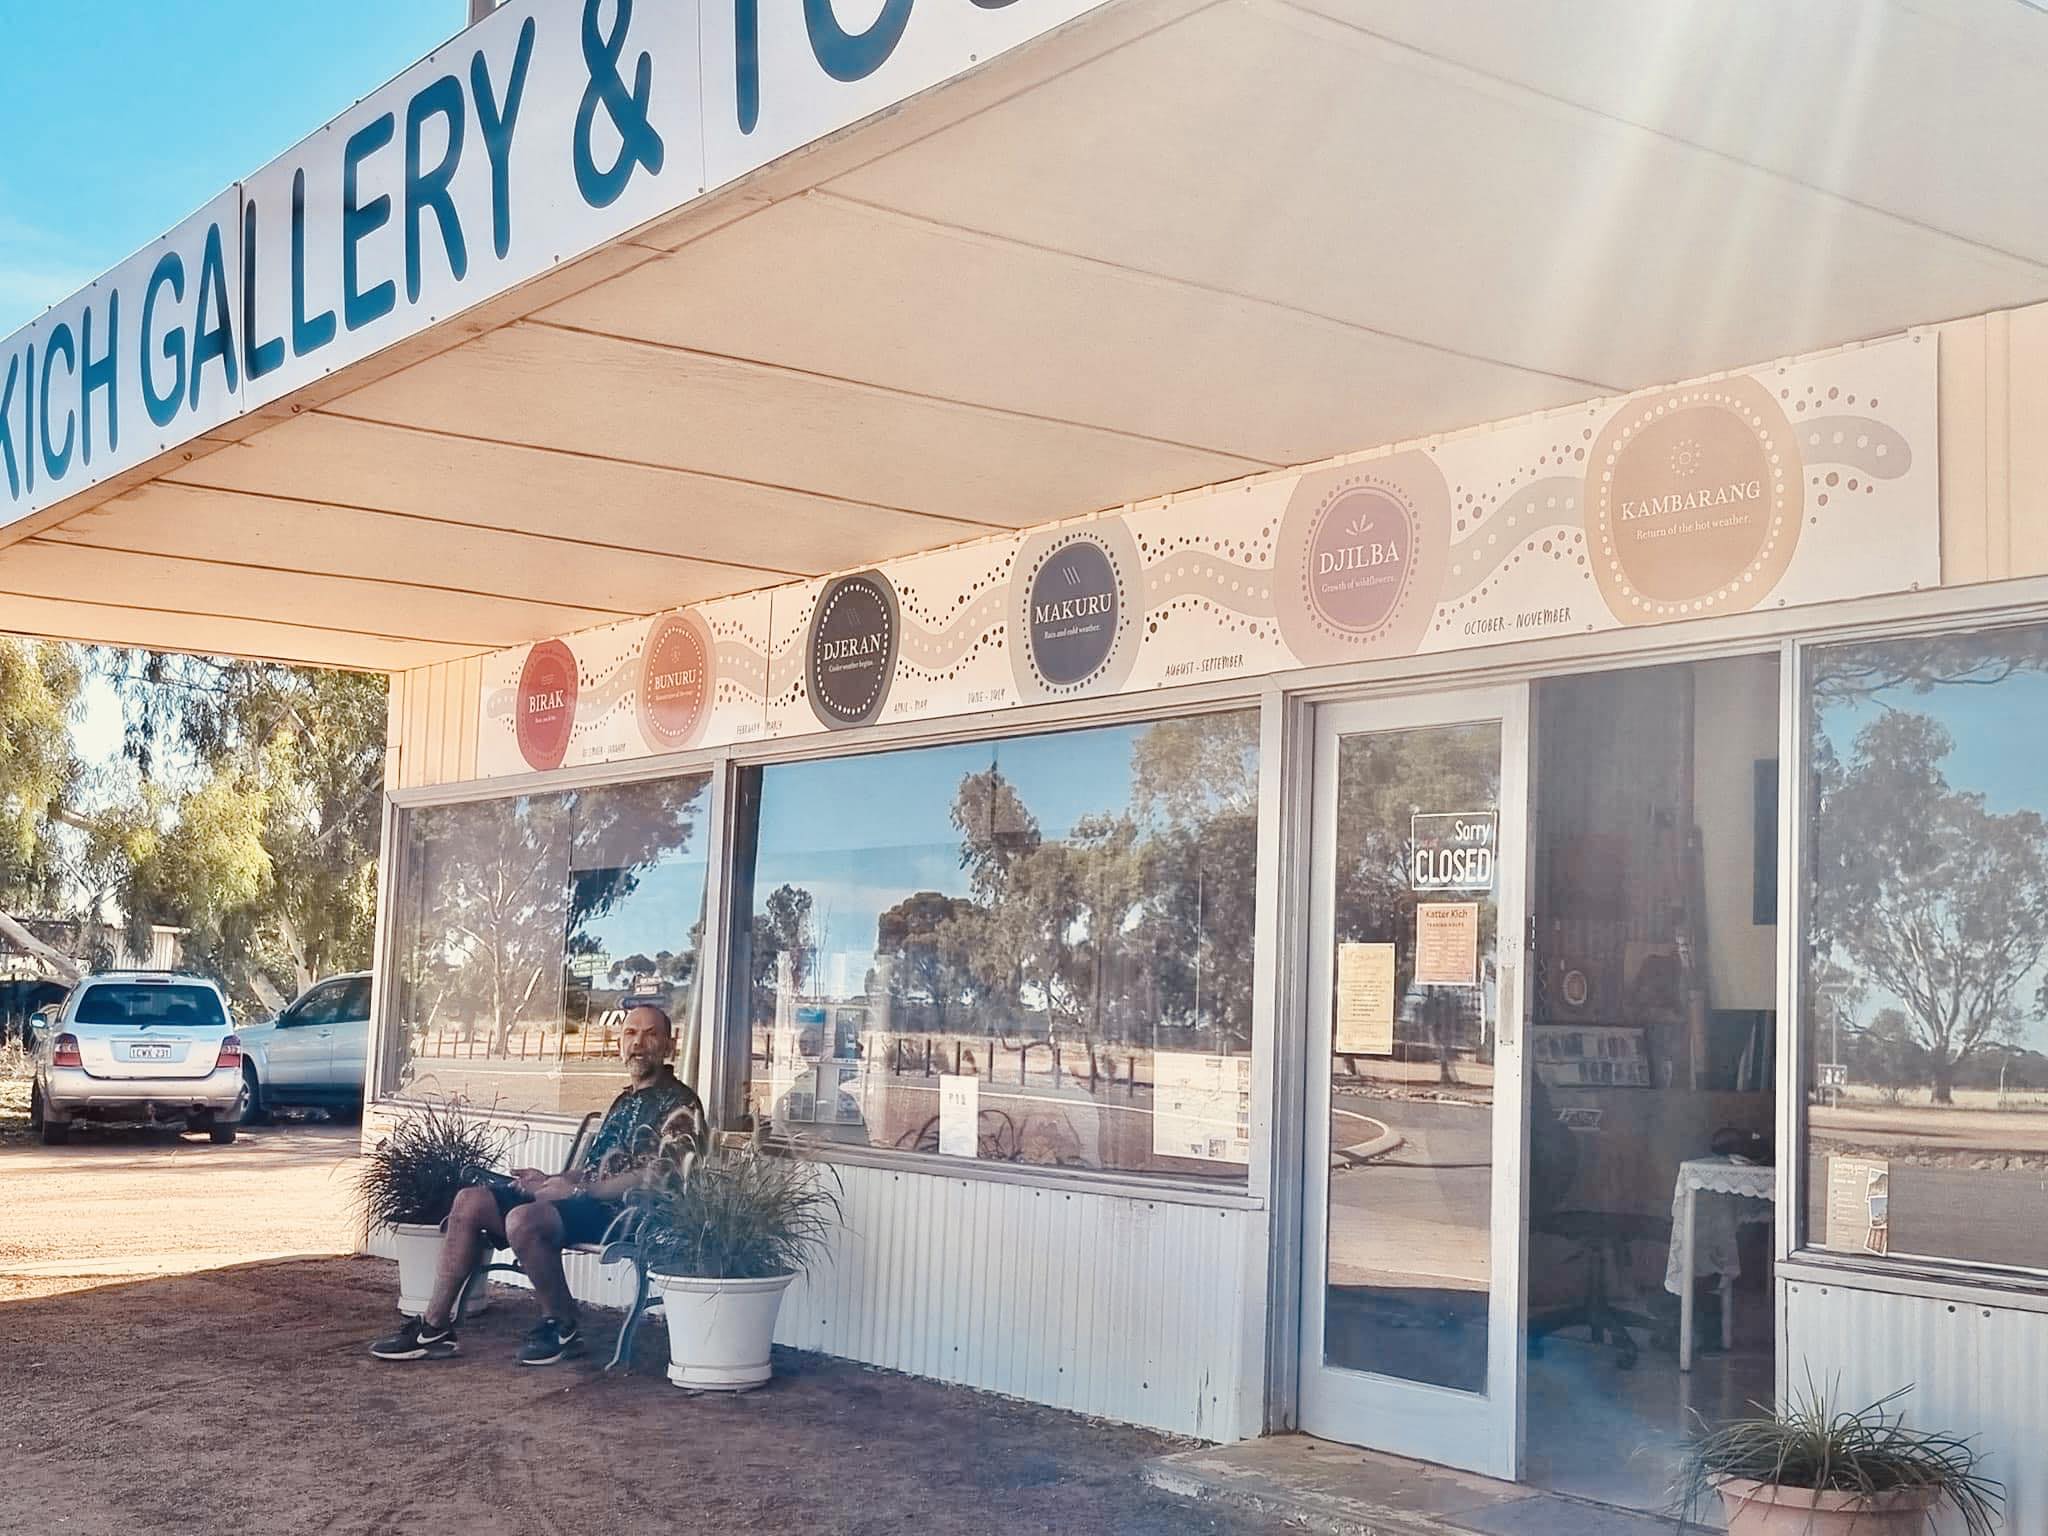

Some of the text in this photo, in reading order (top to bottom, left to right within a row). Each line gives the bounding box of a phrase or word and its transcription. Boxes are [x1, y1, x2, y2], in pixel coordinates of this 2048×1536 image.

[140, 16, 535, 428] GALLERY
[573, 0, 664, 208] &
[1621, 480, 1760, 521] KAMBARANG
[1636, 529, 1667, 540] Return
[1667, 523, 1678, 536] of
[1679, 522, 1693, 533] the
[1695, 519, 1711, 531] hot
[1319, 540, 1400, 575] DJILBA
[1034, 592, 1113, 625] MAKURU
[1464, 616, 1506, 636] OCTOBER
[1516, 607, 1572, 629] NOVEMBER
[823, 632, 882, 661] DJERAN
[654, 668, 697, 690] BUNURU
[1165, 661, 1195, 677] AUGUST
[1201, 654, 1244, 673] SEPTEMBER
[528, 689, 565, 714] BIRAK
[1454, 819, 1491, 846] Sorry
[1415, 848, 1491, 884] CLOSED
